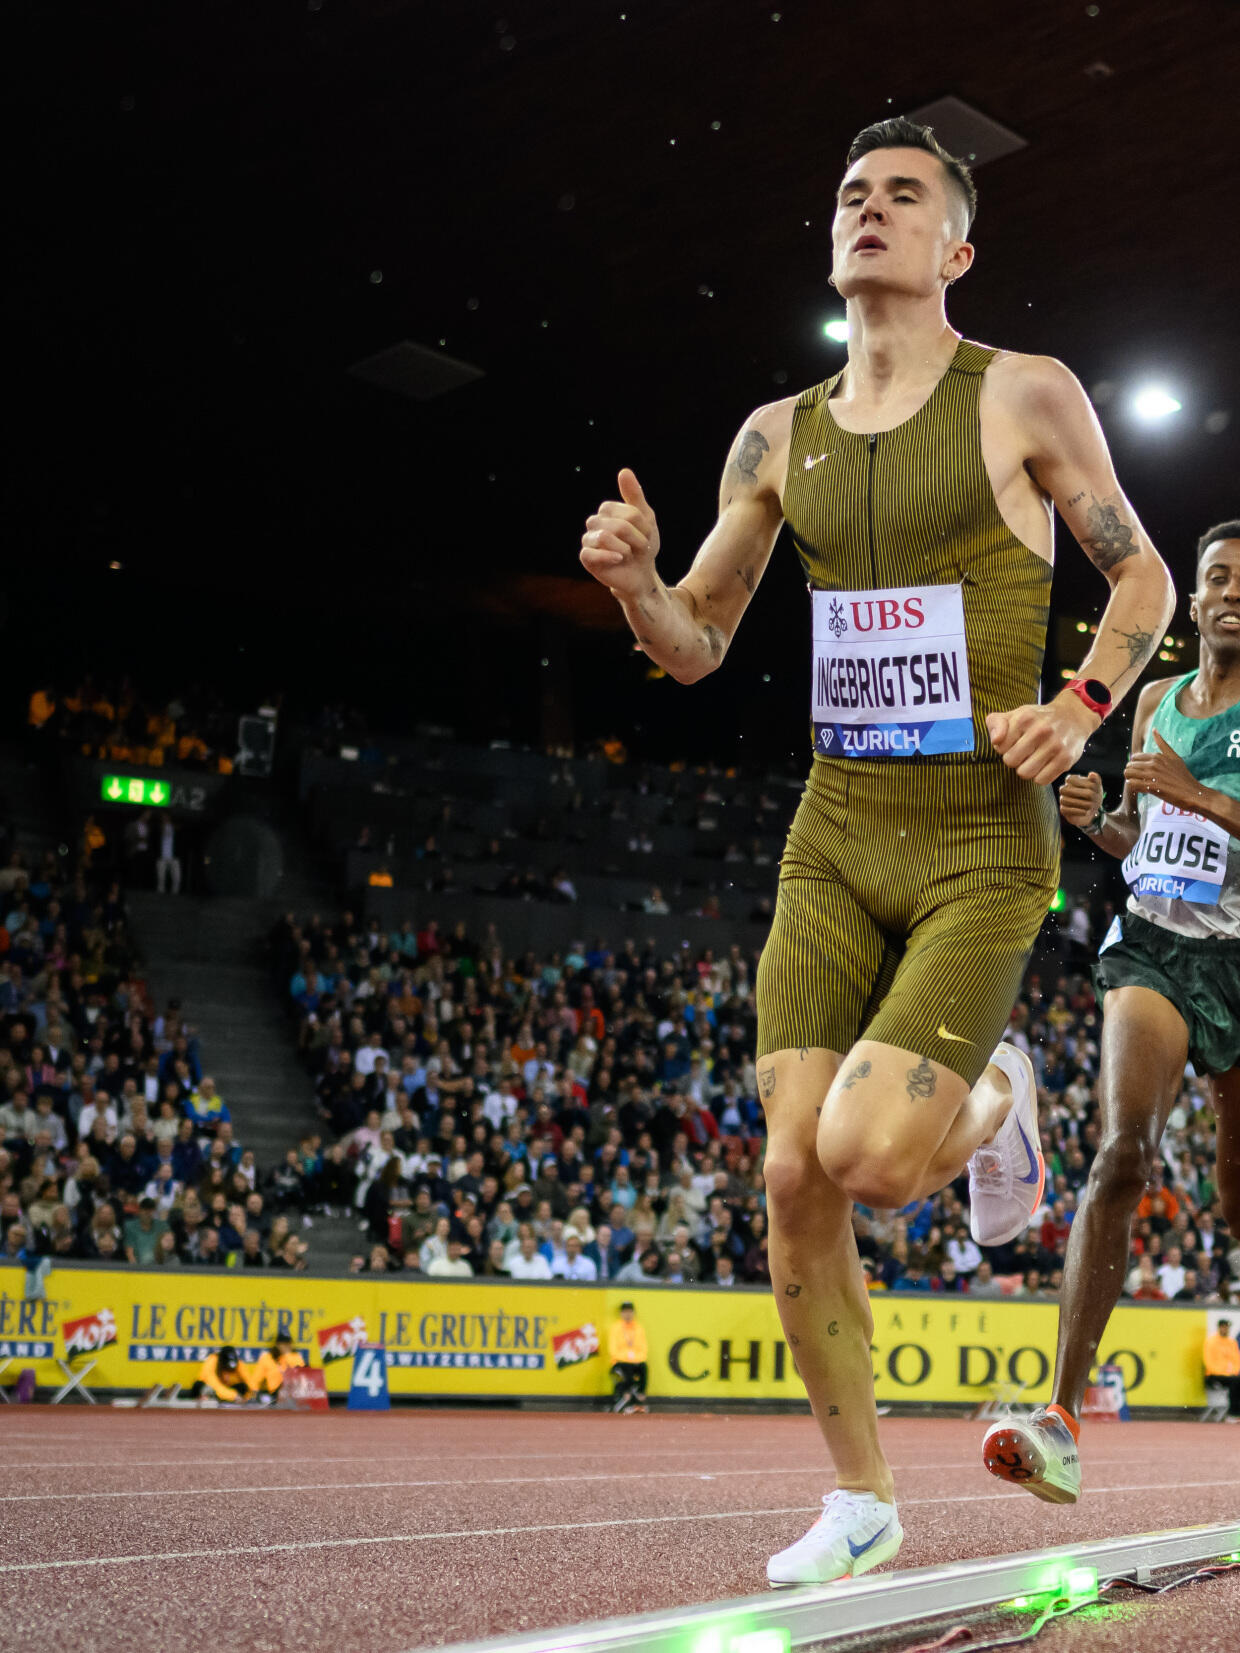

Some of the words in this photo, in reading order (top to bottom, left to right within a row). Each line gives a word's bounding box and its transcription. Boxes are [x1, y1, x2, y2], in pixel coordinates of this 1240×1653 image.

[850, 597, 925, 632] UBS
[817, 651, 961, 708] INGEBRIGTSEN
[842, 729, 920, 751] ZURICH
[1139, 877, 1185, 896] URICH
[131, 1304, 166, 1340] LE
[175, 1301, 313, 1344] GRUYÈRE
[380, 1312, 411, 1346] LE
[419, 1309, 548, 1349] GRUYÈRE
[890, 1311, 987, 1332] AFFÈ
[353, 1351, 384, 1398] 4
[667, 1337, 931, 1386] CHIO
[958, 1345, 1145, 1392] D'OO
